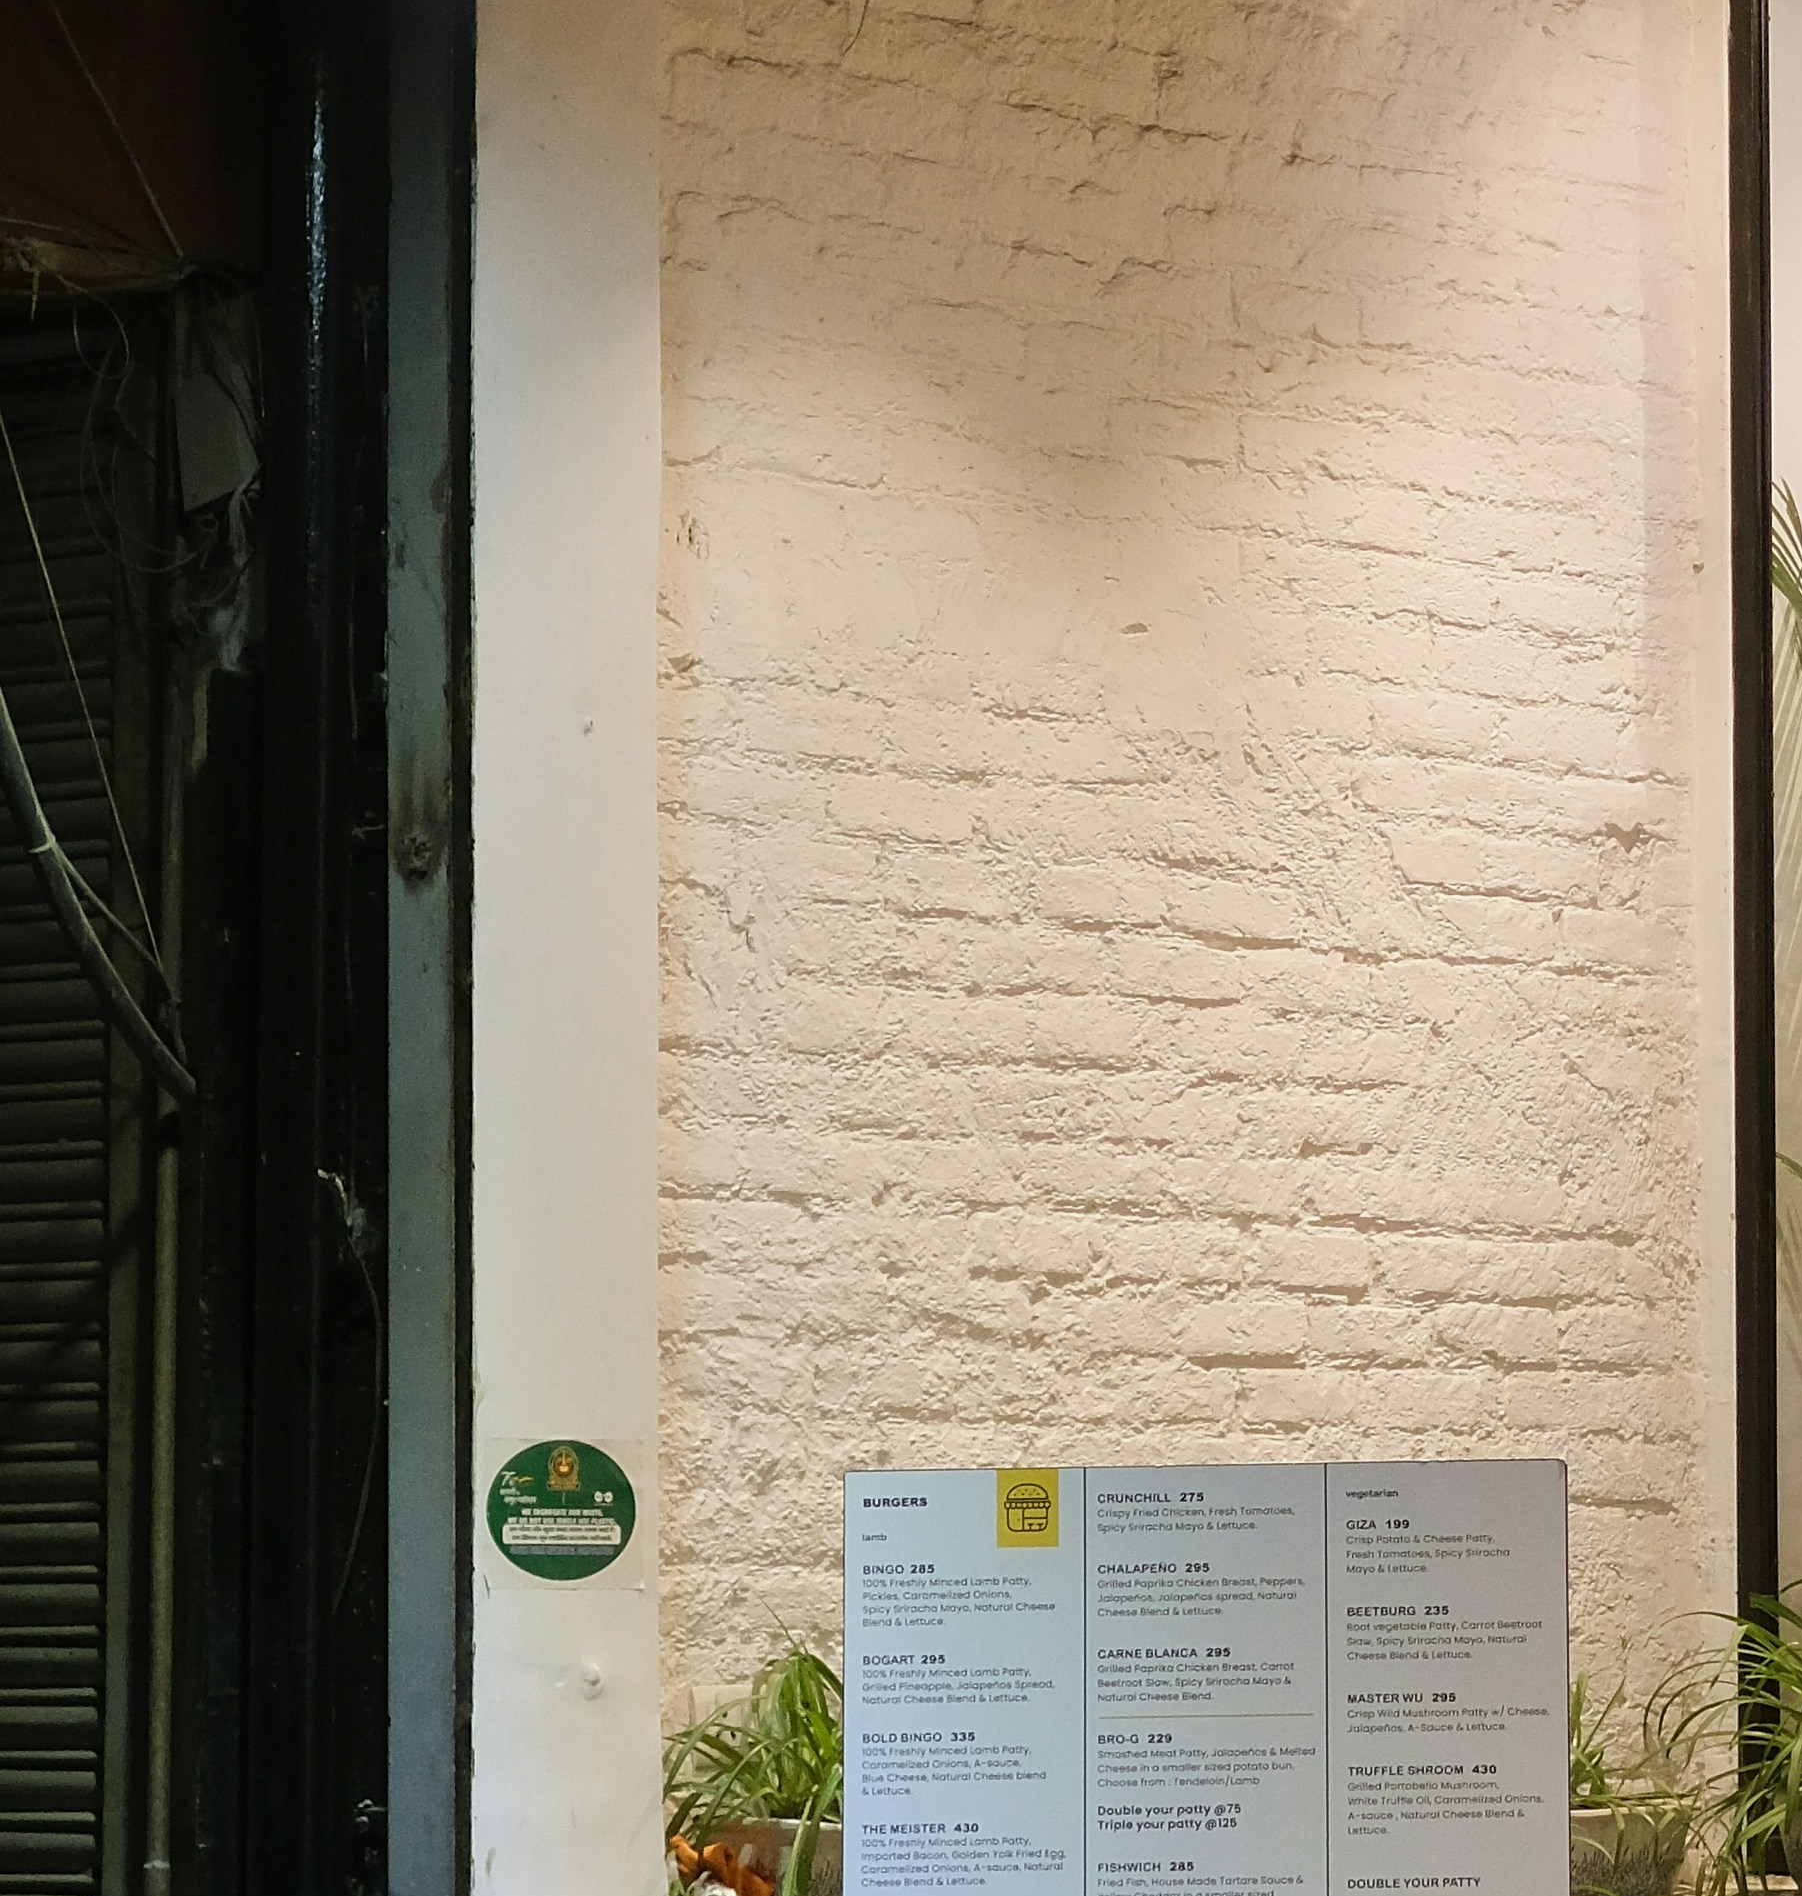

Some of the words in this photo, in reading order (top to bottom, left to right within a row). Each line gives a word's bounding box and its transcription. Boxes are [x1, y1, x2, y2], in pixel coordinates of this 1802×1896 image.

[862, 1496, 928, 1508] BURGERS
[1096, 1491, 1171, 1504] CRUNCHILL
[1178, 1491, 1204, 1503] 275
[1345, 1518, 1377, 1530] GIZA
[1384, 1518, 1410, 1529] 199
[862, 1563, 904, 1575] BINGO
[909, 1563, 935, 1574] 285
[1184, 1561, 1210, 1573] 295
[1346, 1605, 1416, 1617] BEETBURG
[1423, 1604, 1449, 1616] 235
[1096, 1647, 1142, 1659] CARNE
[1144, 1646, 1198, 1659] BLANCA
[1205, 1646, 1231, 1658] 295
[862, 1653, 915, 1666] BOGART
[920, 1653, 946, 1665] 295
[1346, 1692, 1400, 1704] MASTER
[1401, 1692, 1423, 1703] WU
[1431, 1691, 1456, 1703] 295
[861, 1732, 898, 1744] BOLD
[900, 1731, 942, 1743] BINGO
[950, 1731, 976, 1742] 335
[1097, 1733, 1139, 1745] BRO-G
[1146, 1732, 1172, 1744] 229
[1347, 1765, 1404, 1777] TRUFFLE
[1406, 1764, 1464, 1776] SHROOM
[1470, 1763, 1497, 1775] 430
[1096, 1804, 1142, 1816] Double
[1144, 1805, 1174, 1818] your
[1176, 1803, 1211, 1817] patty
[861, 1823, 886, 1835] THE
[889, 1822, 946, 1834] MEISTER
[952, 1822, 979, 1833] 430
[1096, 1818, 1133, 1833] Triple
[1135, 1820, 1165, 1832] your
[1167, 1818, 1202, 1832] patty
[1096, 1861, 1161, 1873] FISHWICH
[1168, 1860, 1194, 1872] 285
[1346, 1877, 1400, 1889] DOUBLE
[1402, 1876, 1439, 1888] YOUR
[1442, 1876, 1480, 1888] PATTY
